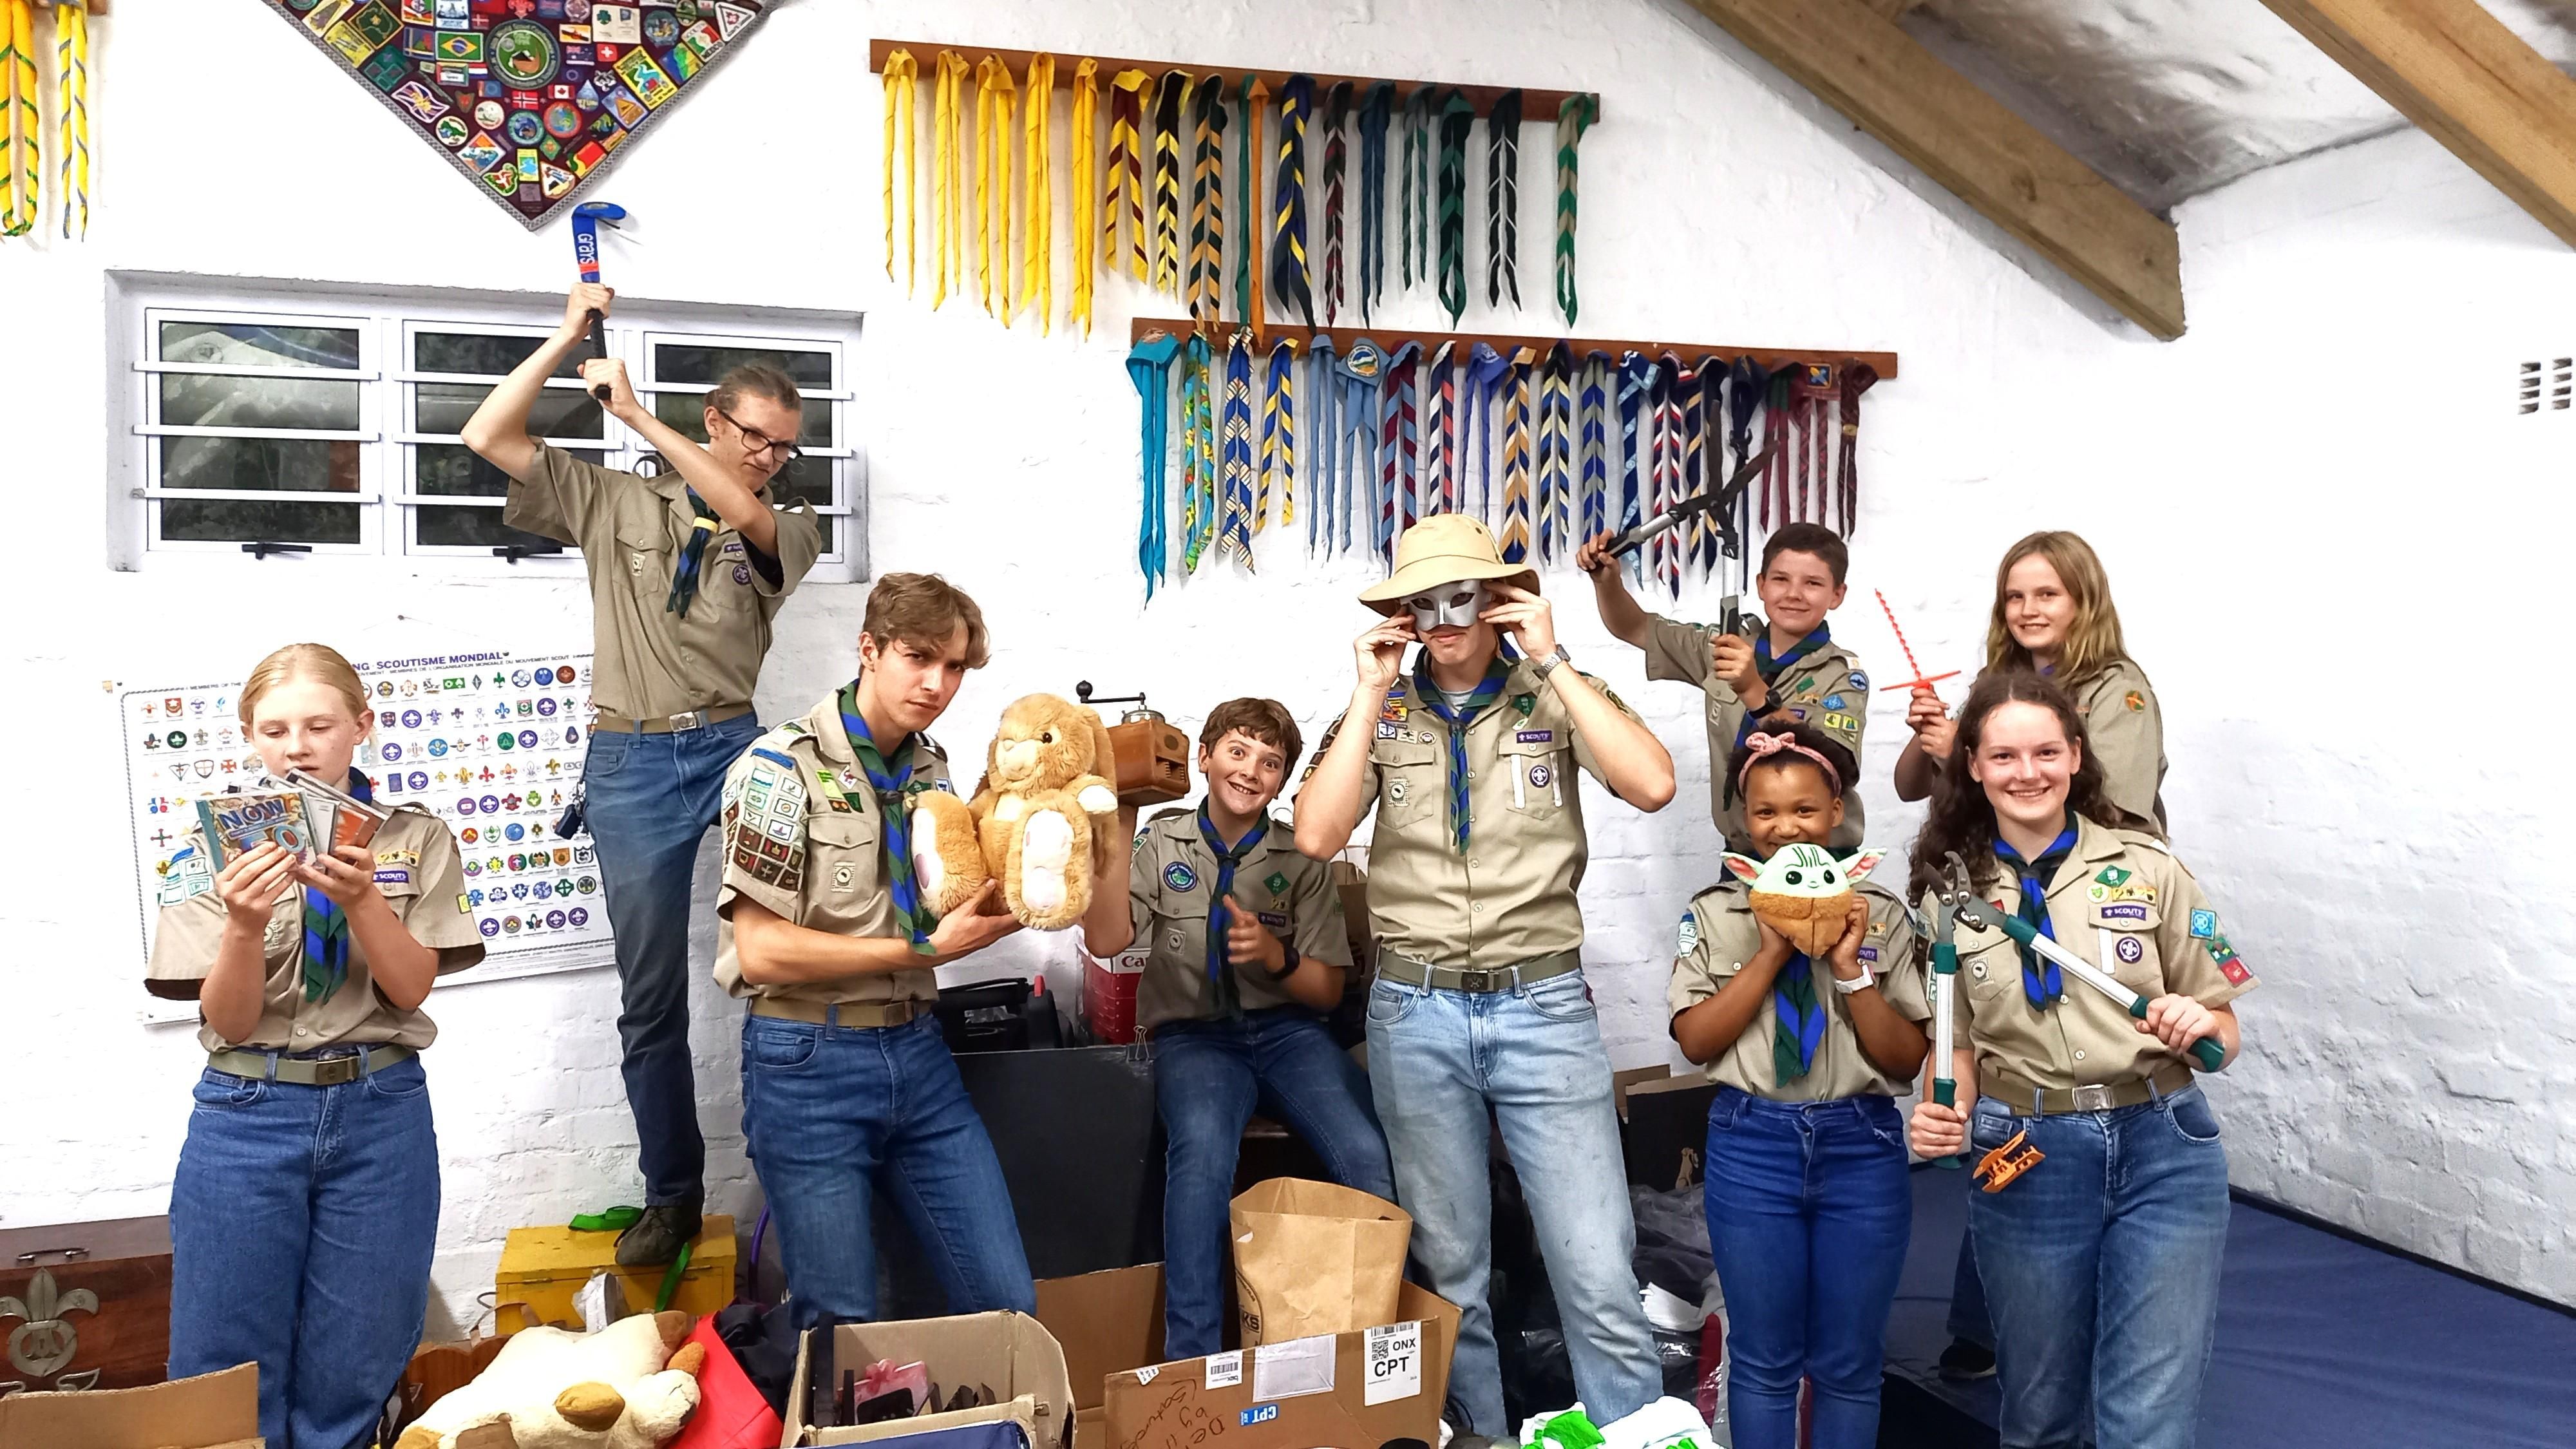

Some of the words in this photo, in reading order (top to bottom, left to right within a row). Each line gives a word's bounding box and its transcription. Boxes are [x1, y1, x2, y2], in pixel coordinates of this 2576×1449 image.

[352, 662, 370, 671] NG
[377, 656, 446, 670] SCOUTISME
[449, 652, 503, 664] MONDIAL
[219, 799, 285, 830] NOW
[2114, 907, 2144, 918] SCOUTS
[1122, 956, 1145, 967] Ca
[1392, 1338, 1416, 1351] ONX
[1374, 1356, 1410, 1377] CPT
[1251, 1406, 1277, 1423] CPT
